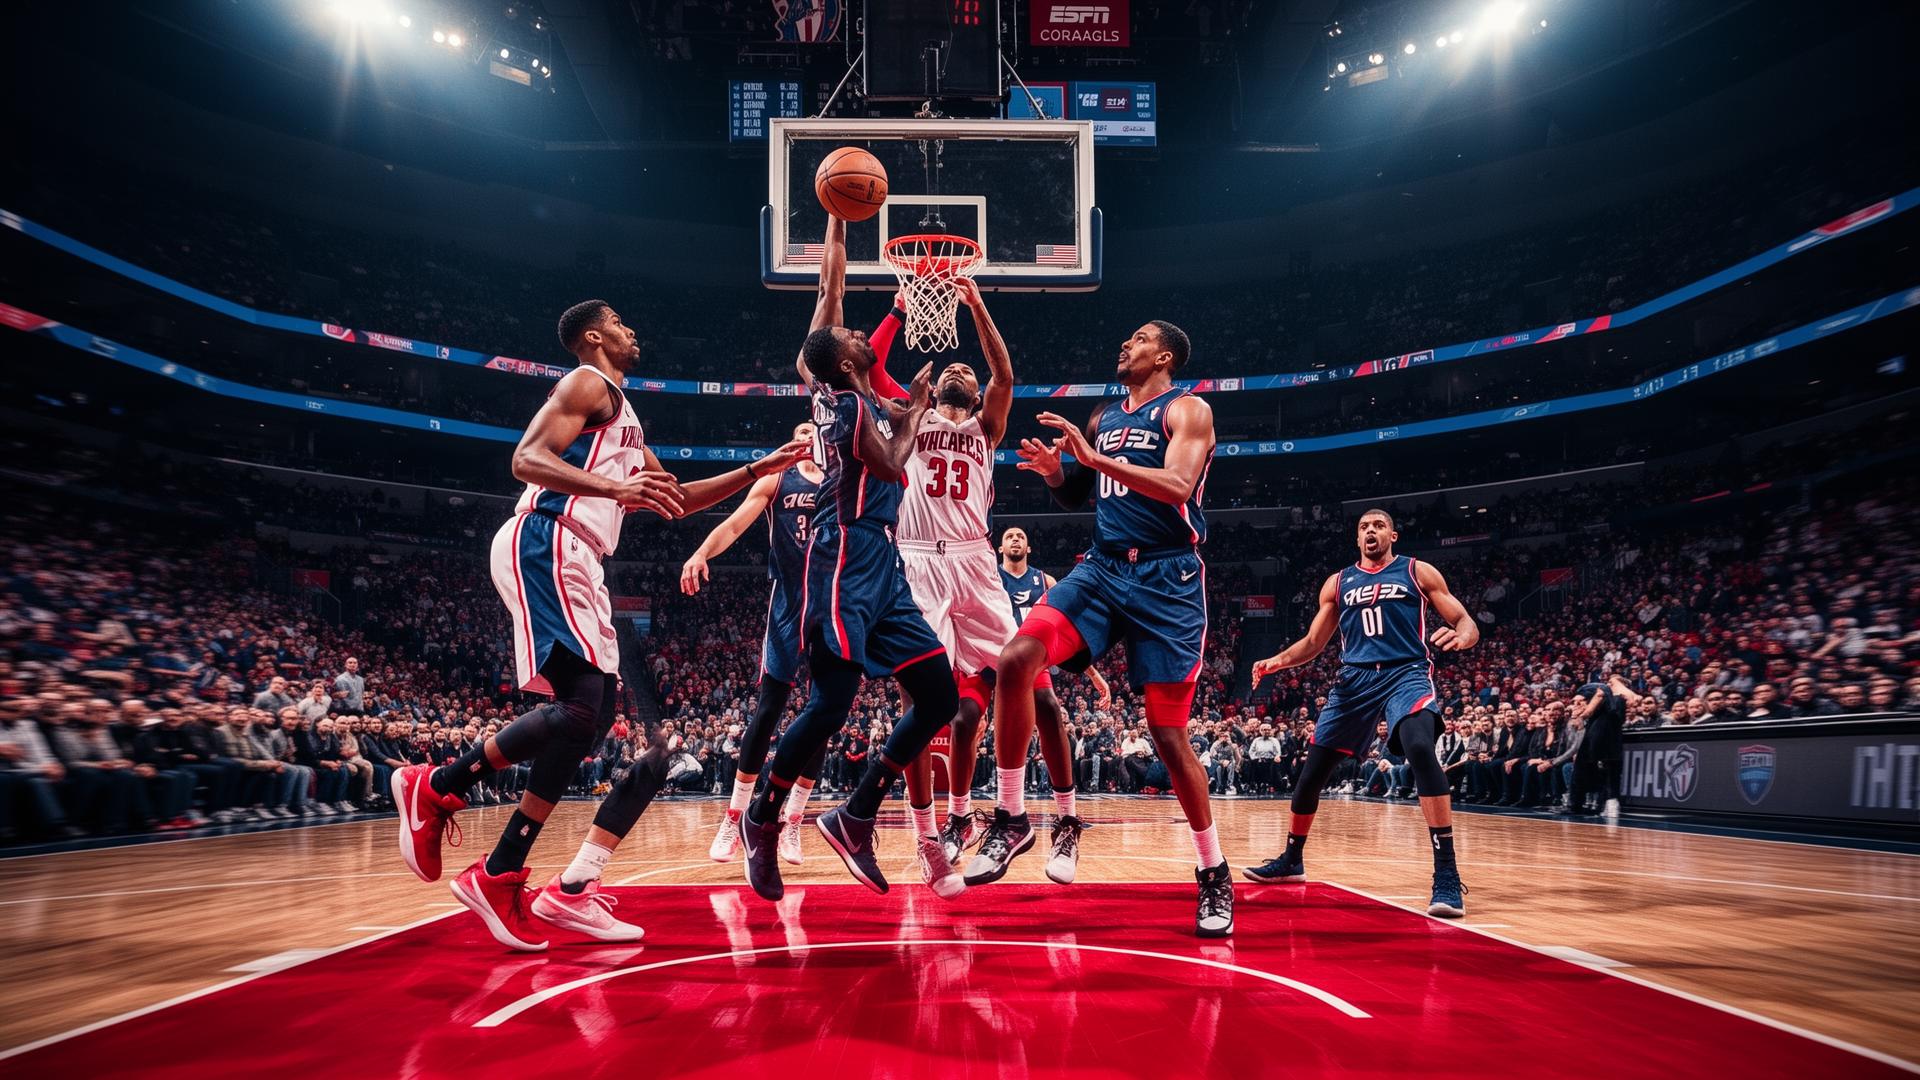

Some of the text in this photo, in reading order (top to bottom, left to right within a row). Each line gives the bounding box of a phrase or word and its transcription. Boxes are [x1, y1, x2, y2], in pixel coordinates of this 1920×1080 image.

[1049, 6, 1110, 24] ESPN
[1040, 29, 1120, 42] CORAAGLS
[926, 456, 970, 501] 33
[1361, 606, 1383, 637] 01
